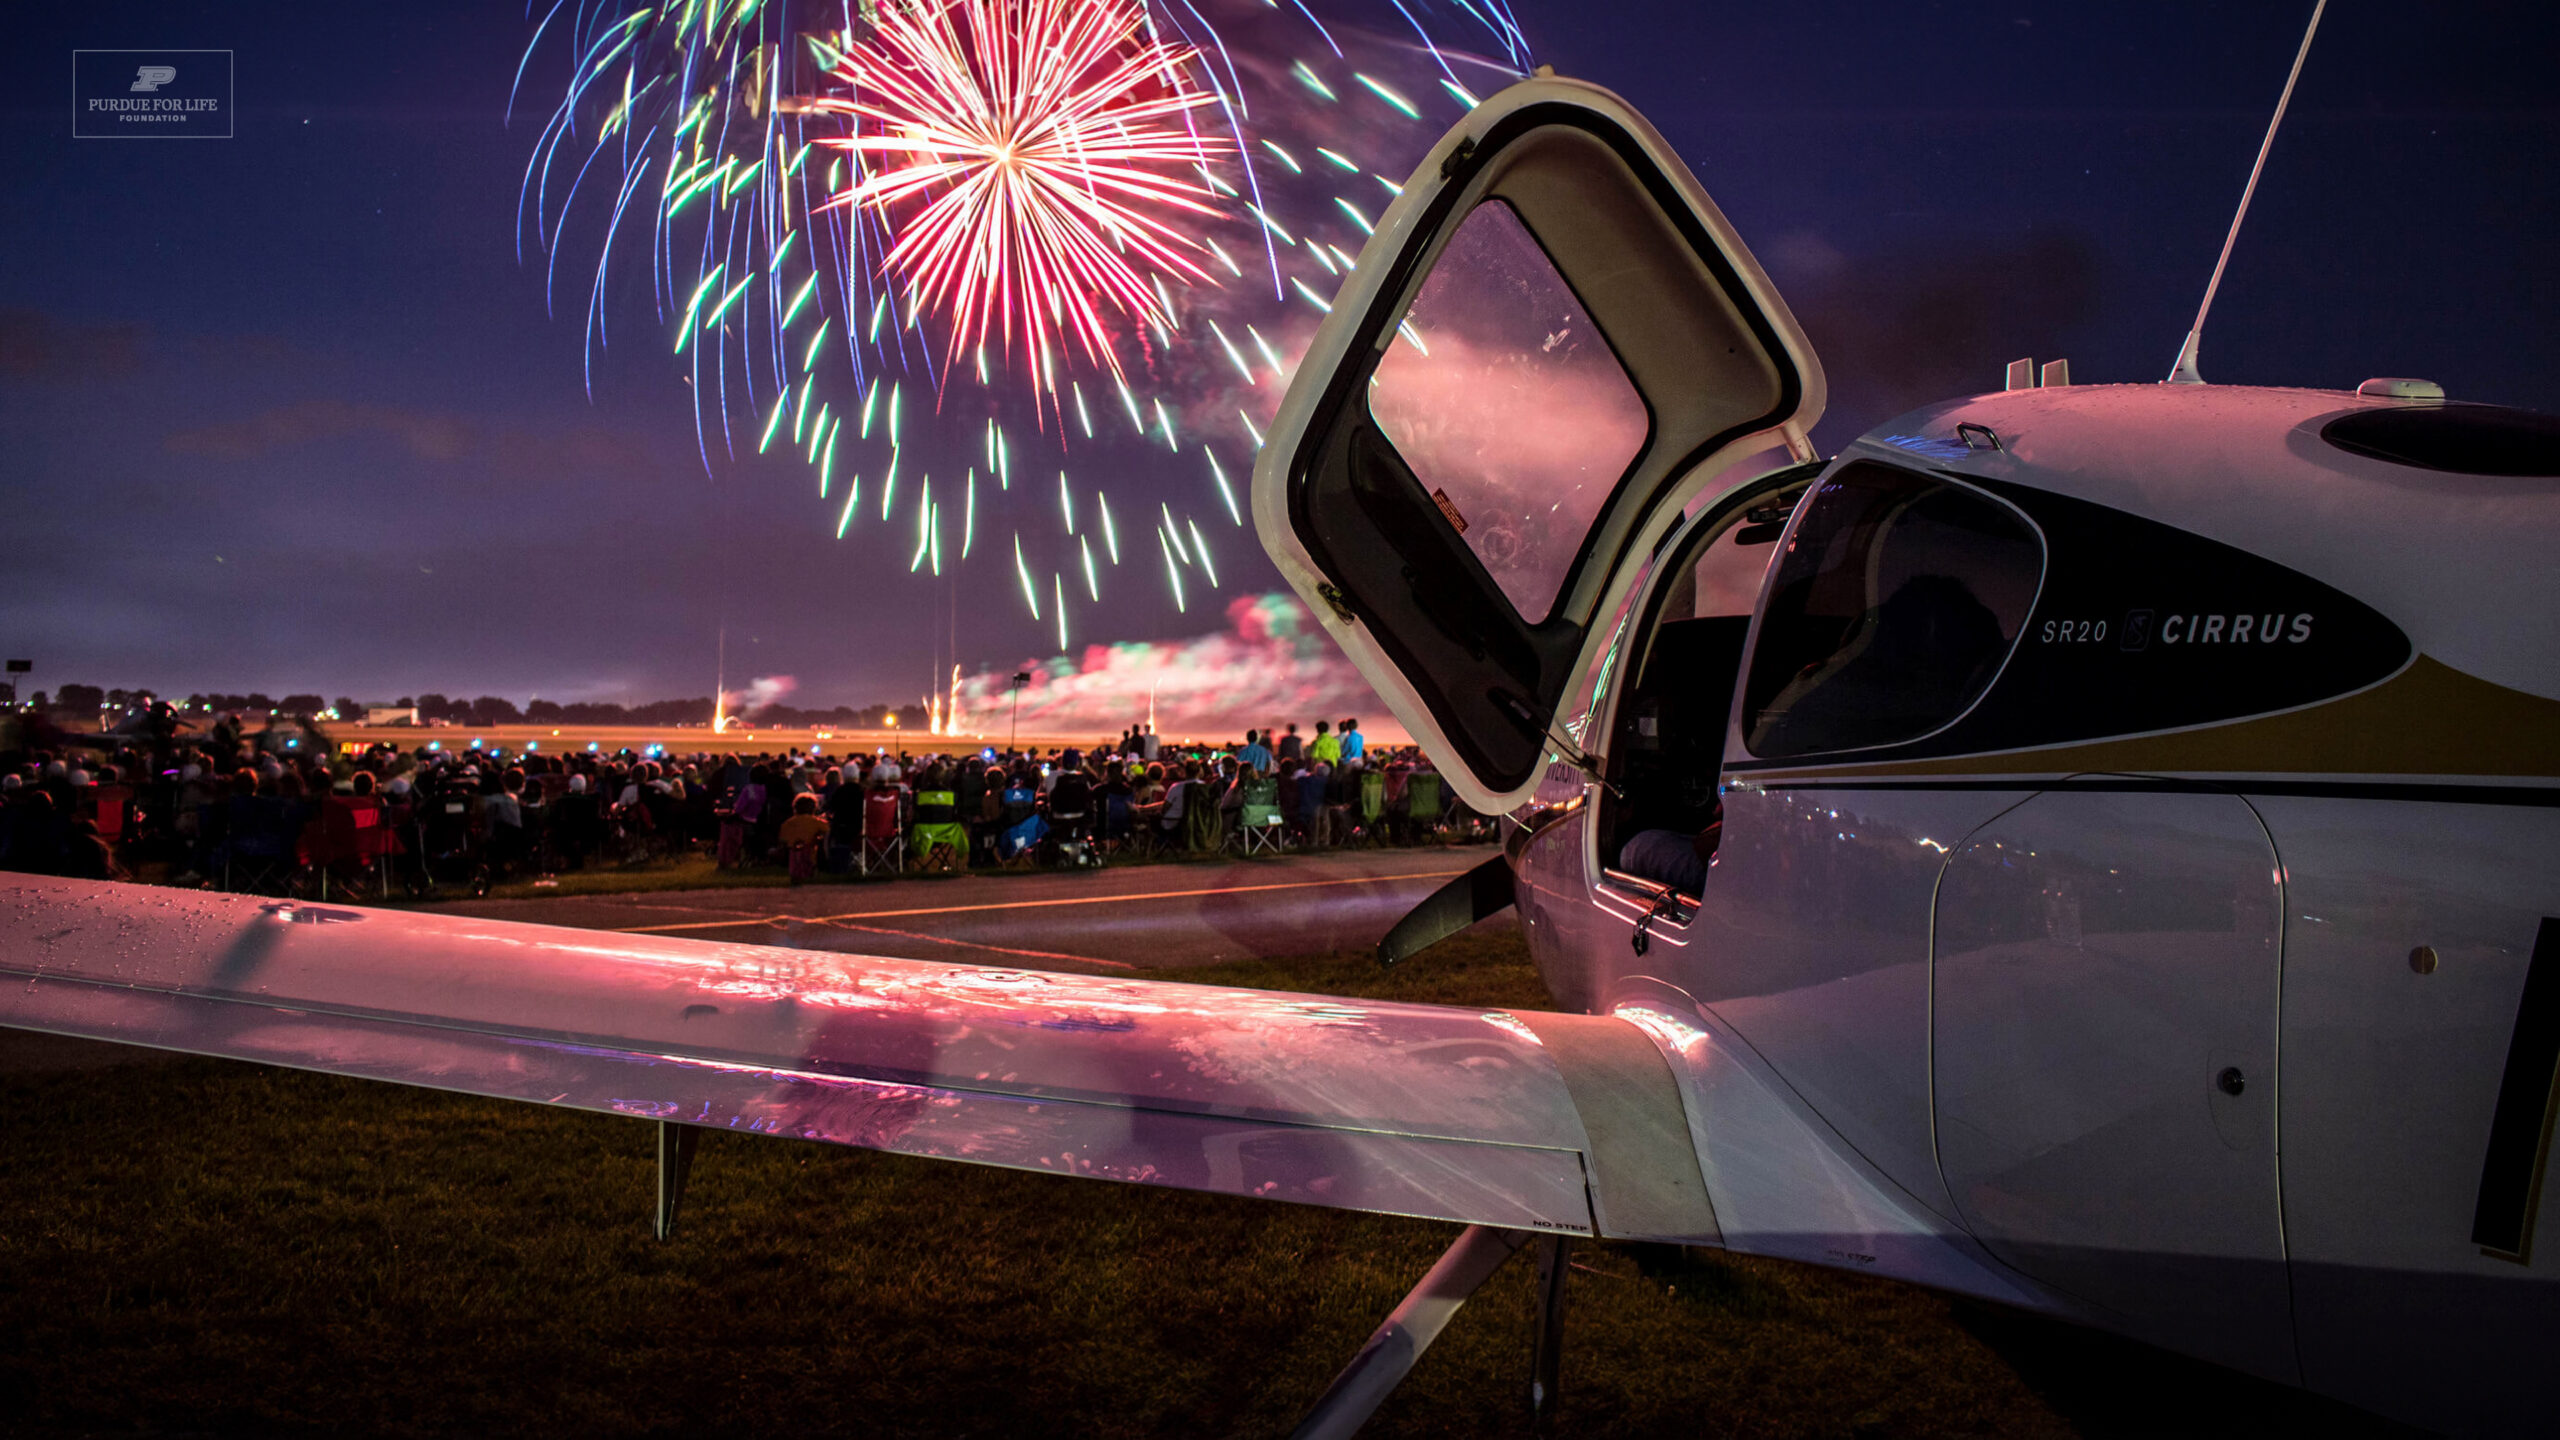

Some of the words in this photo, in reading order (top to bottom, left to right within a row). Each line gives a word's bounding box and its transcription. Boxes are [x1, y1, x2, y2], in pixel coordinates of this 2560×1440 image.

[2042, 620, 2107, 643] SR20
[2161, 613, 2314, 644] CIRRUS
[1533, 1220, 1552, 1228] NO
[1555, 1223, 1588, 1231] STEP
